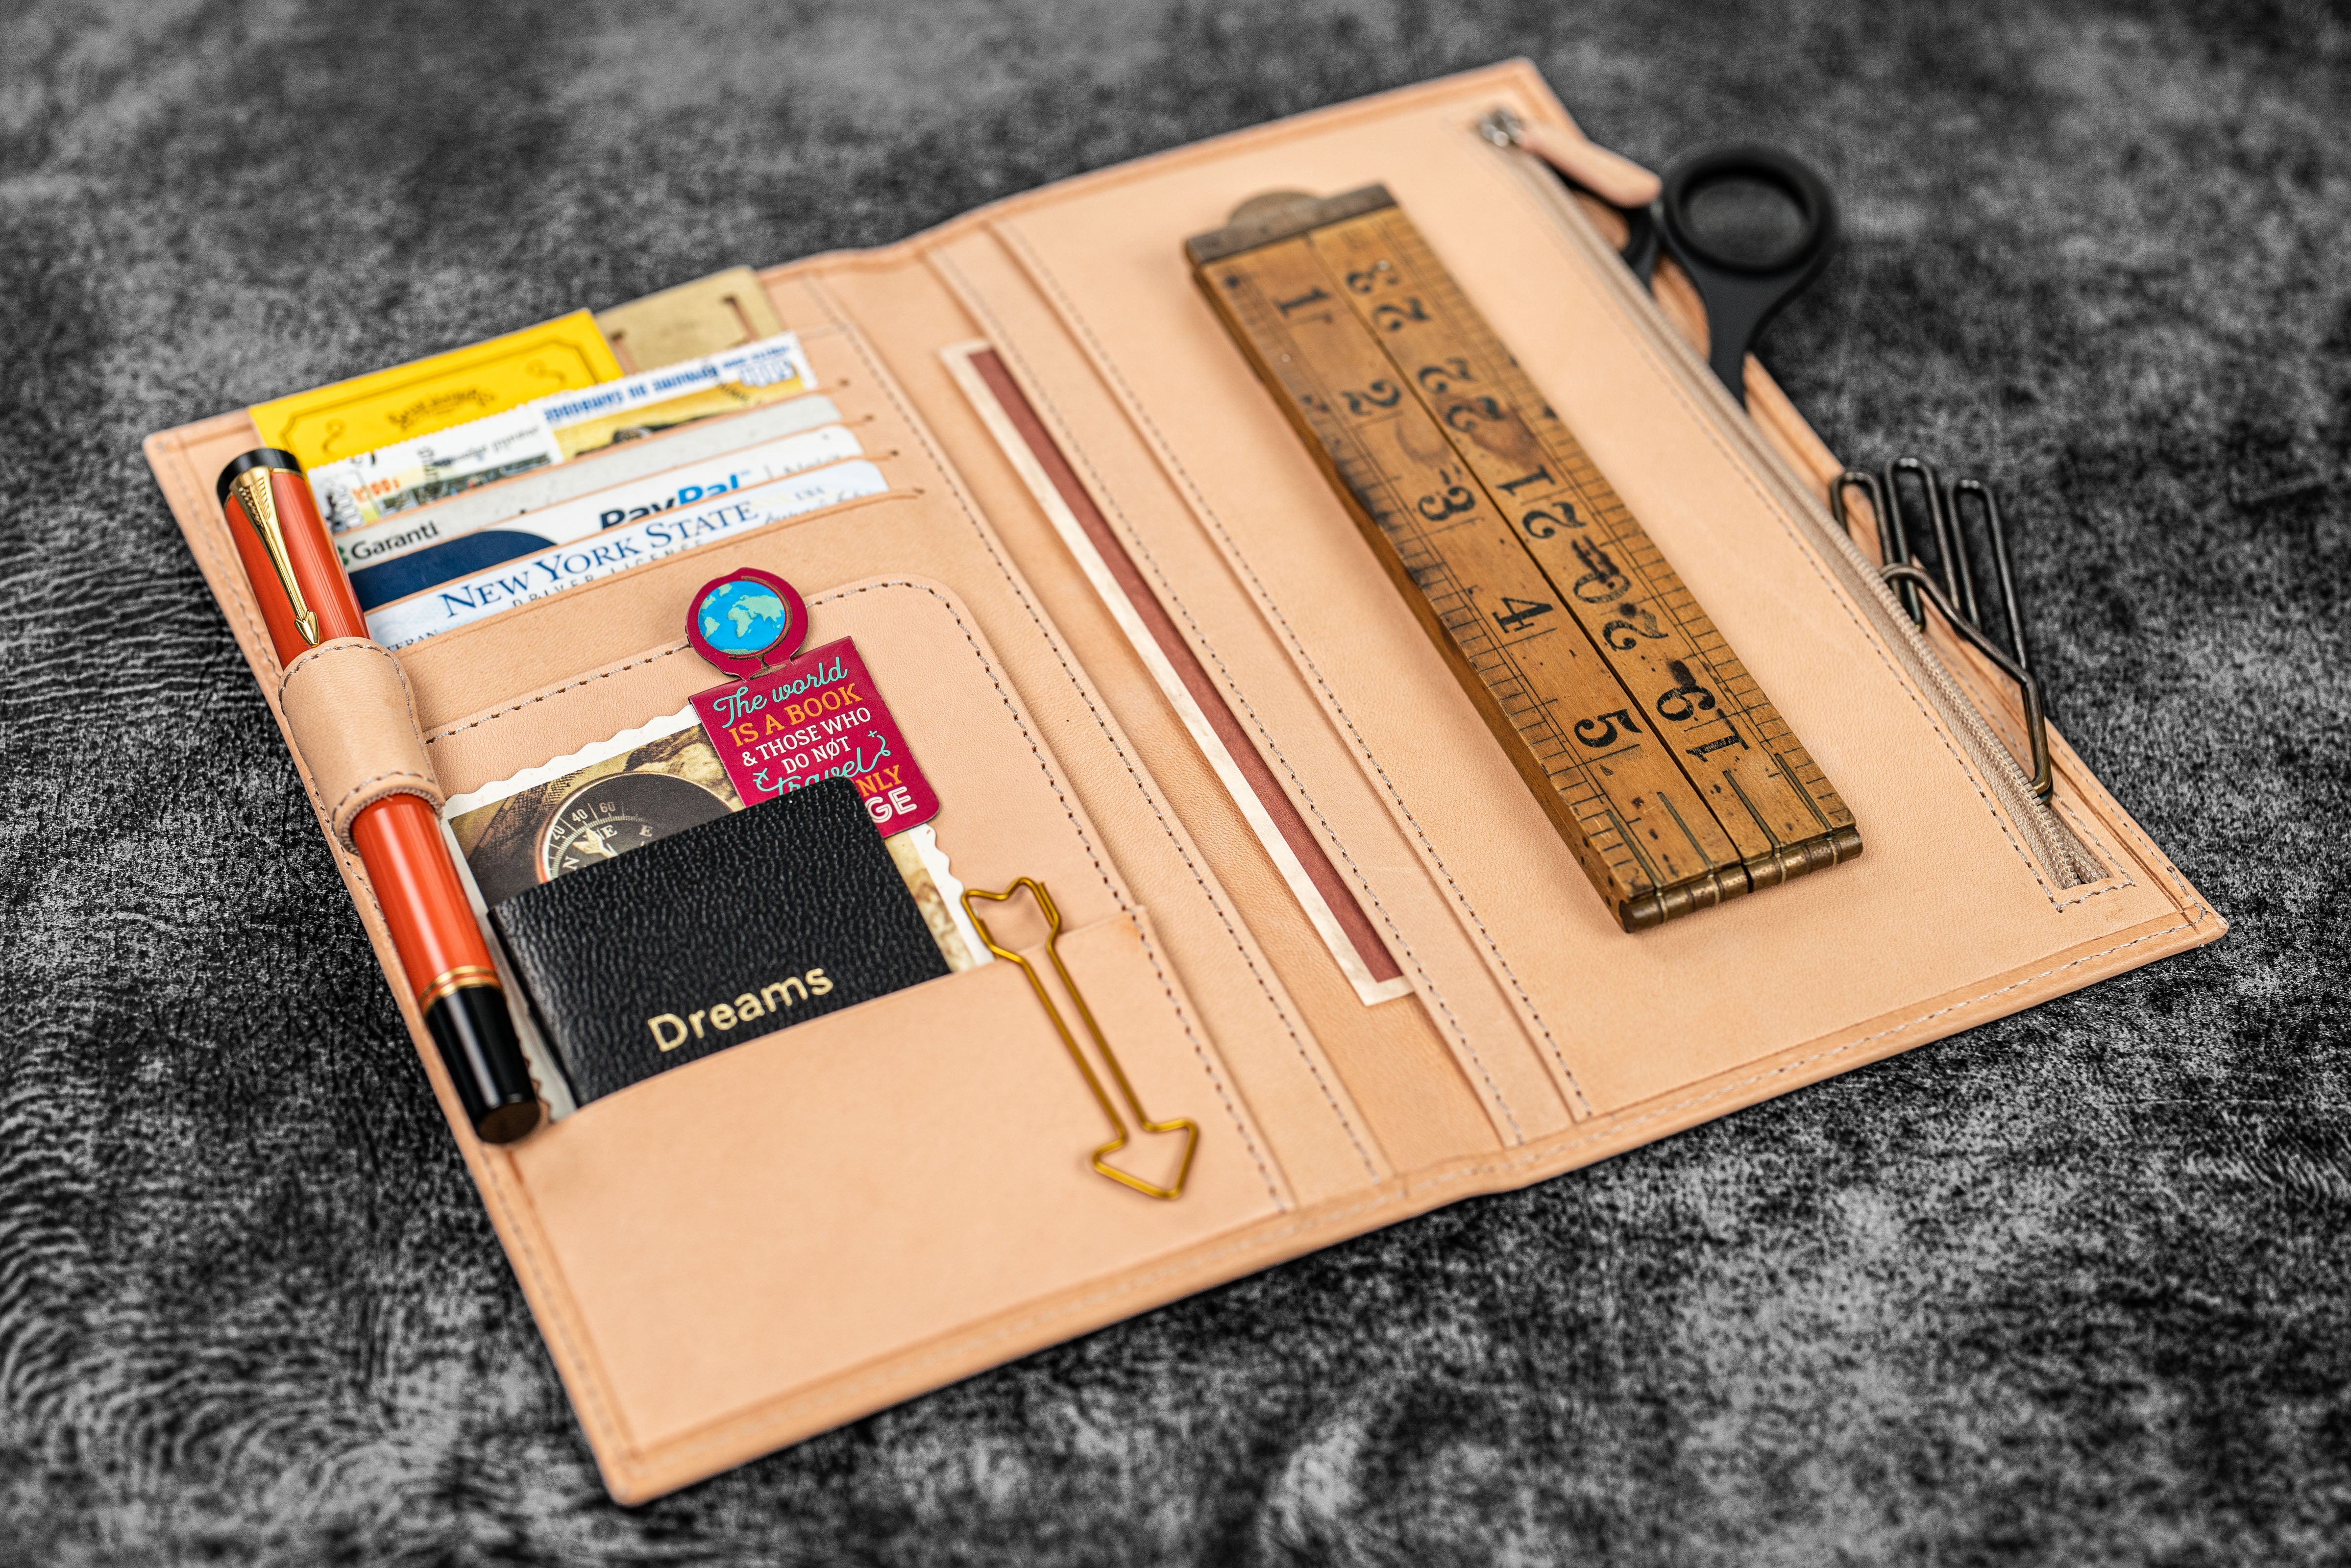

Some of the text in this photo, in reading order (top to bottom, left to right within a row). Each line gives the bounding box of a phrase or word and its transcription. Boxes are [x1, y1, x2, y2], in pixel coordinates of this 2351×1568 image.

[1274, 285, 1331, 318] 1
[1341, 380, 1402, 416] 2
[1418, 485, 1476, 522] 3
[351, 520, 439, 561] Garanti
[439, 571, 529, 618] NEW
[532, 537, 644, 583] YORK
[645, 500, 759, 548] STATE
[1493, 596, 1556, 635] 4
[387, 629, 438, 652] TERAN
[713, 656, 848, 728] The world
[729, 683, 863, 747] IS A BOOK
[1573, 709, 1642, 749] 5
[742, 707, 871, 767] & THOSE WHO
[782, 753, 809, 774] DO
[856, 765, 902, 798] NLY
[571, 809, 588, 823] 40
[599, 801, 616, 813] 60
[865, 786, 917, 823] GE
[551, 825, 565, 841] 20
[638, 824, 654, 837] E
[563, 856, 580, 871] N
[647, 968, 834, 1053] Dreams
